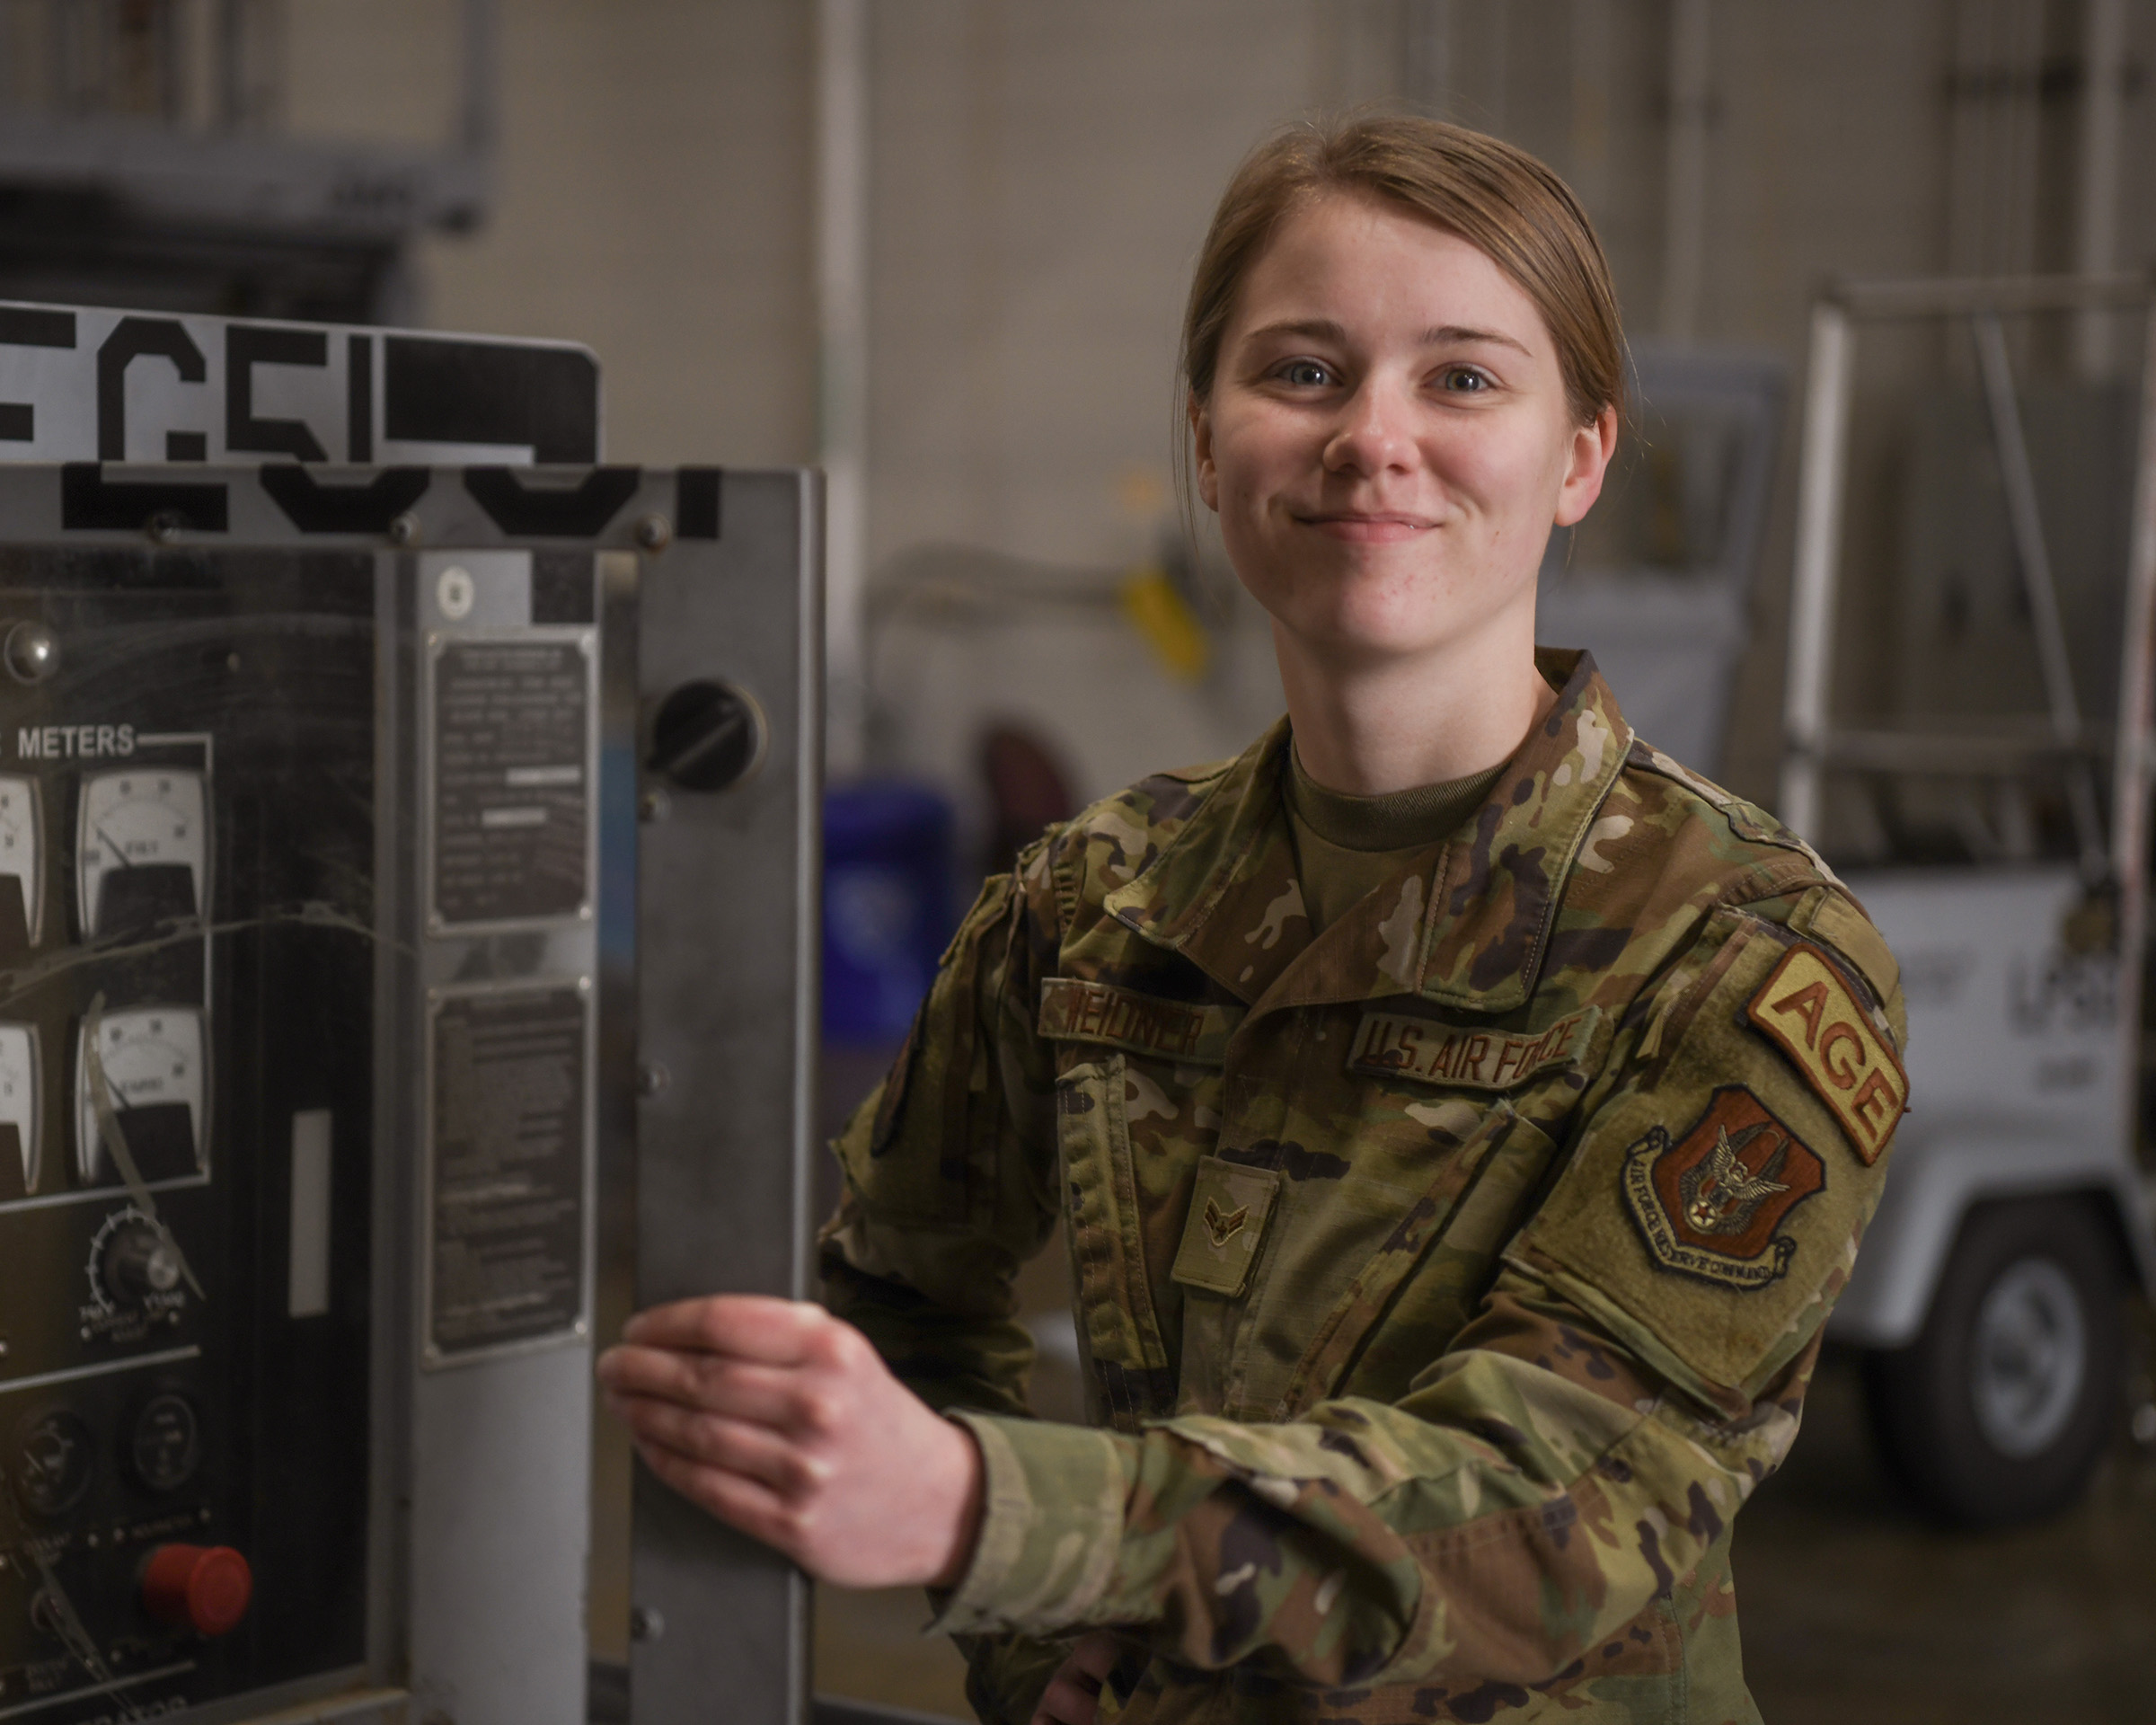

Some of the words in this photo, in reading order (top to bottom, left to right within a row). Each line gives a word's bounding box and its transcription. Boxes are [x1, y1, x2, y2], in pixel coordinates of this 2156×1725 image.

[18, 724, 136, 758] METERS
[1365, 1020, 1424, 1072] U.S.
[1428, 1034, 1490, 1082] AIR
[1492, 1017, 1582, 1083] FORCE
[1772, 980, 1900, 1144] AGE
[1630, 1158, 1647, 1185] AIR
[1637, 1186, 1661, 1232] FORCE
